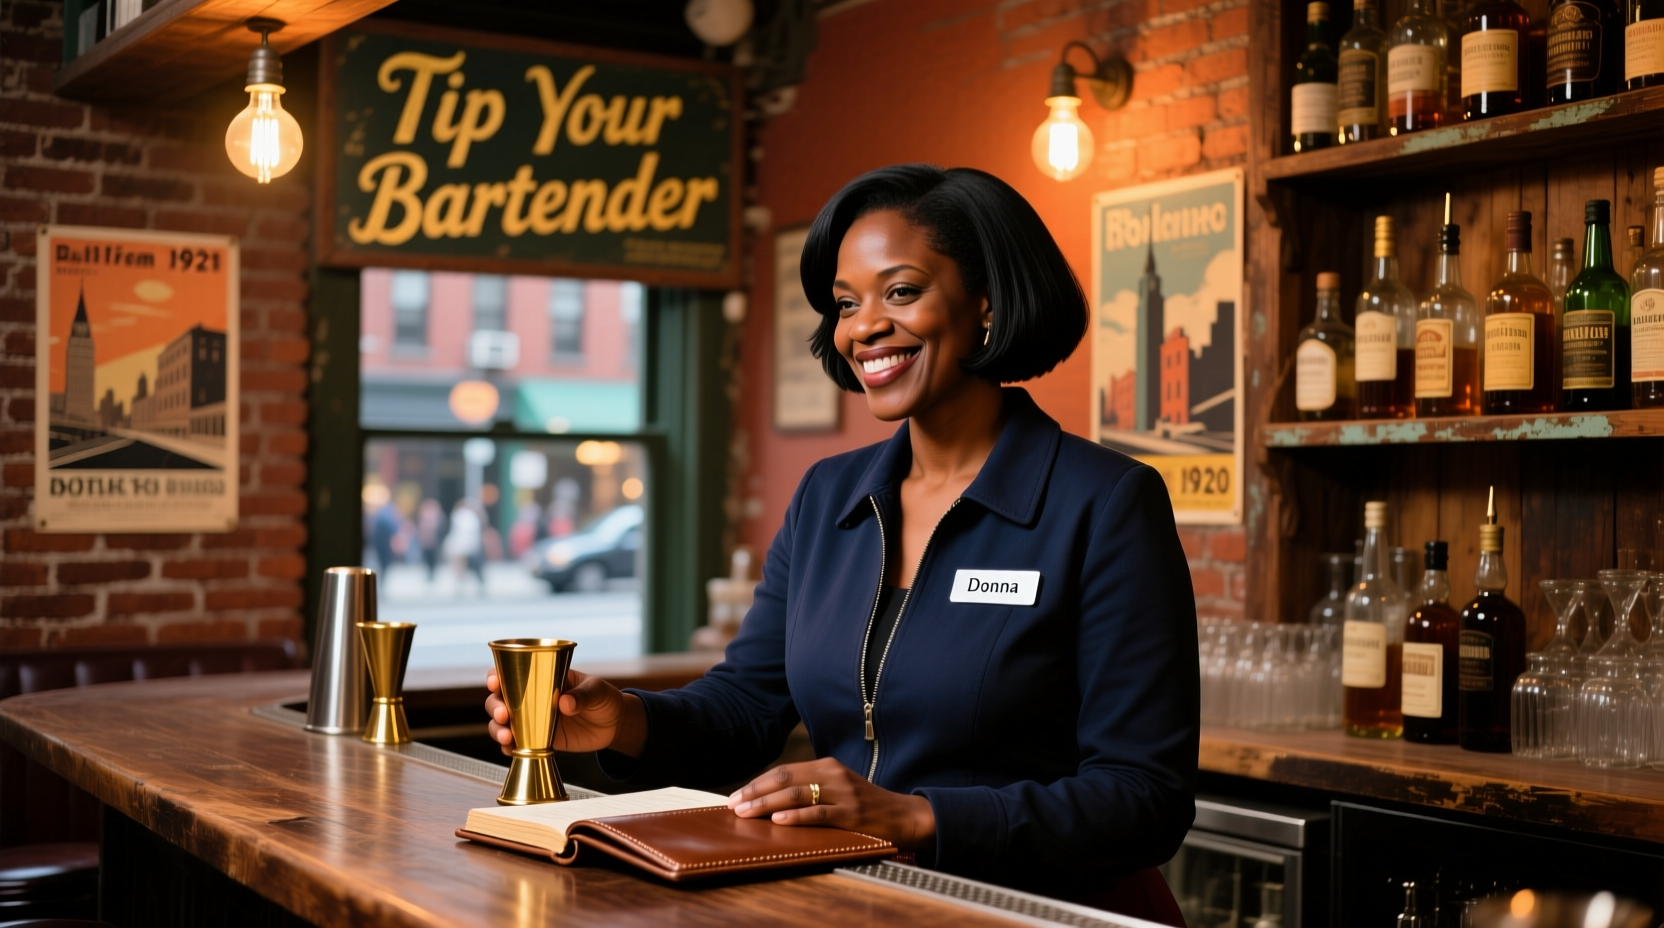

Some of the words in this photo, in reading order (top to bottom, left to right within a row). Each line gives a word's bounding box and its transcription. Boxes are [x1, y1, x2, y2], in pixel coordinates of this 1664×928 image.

[377, 50, 506, 168] Tip
[525, 65, 683, 155] Your
[348, 151, 719, 246] Bartender
[169, 248, 222, 273] 1921
[1181, 466, 1230, 495] 1920
[967, 577, 1018, 594] Donna
